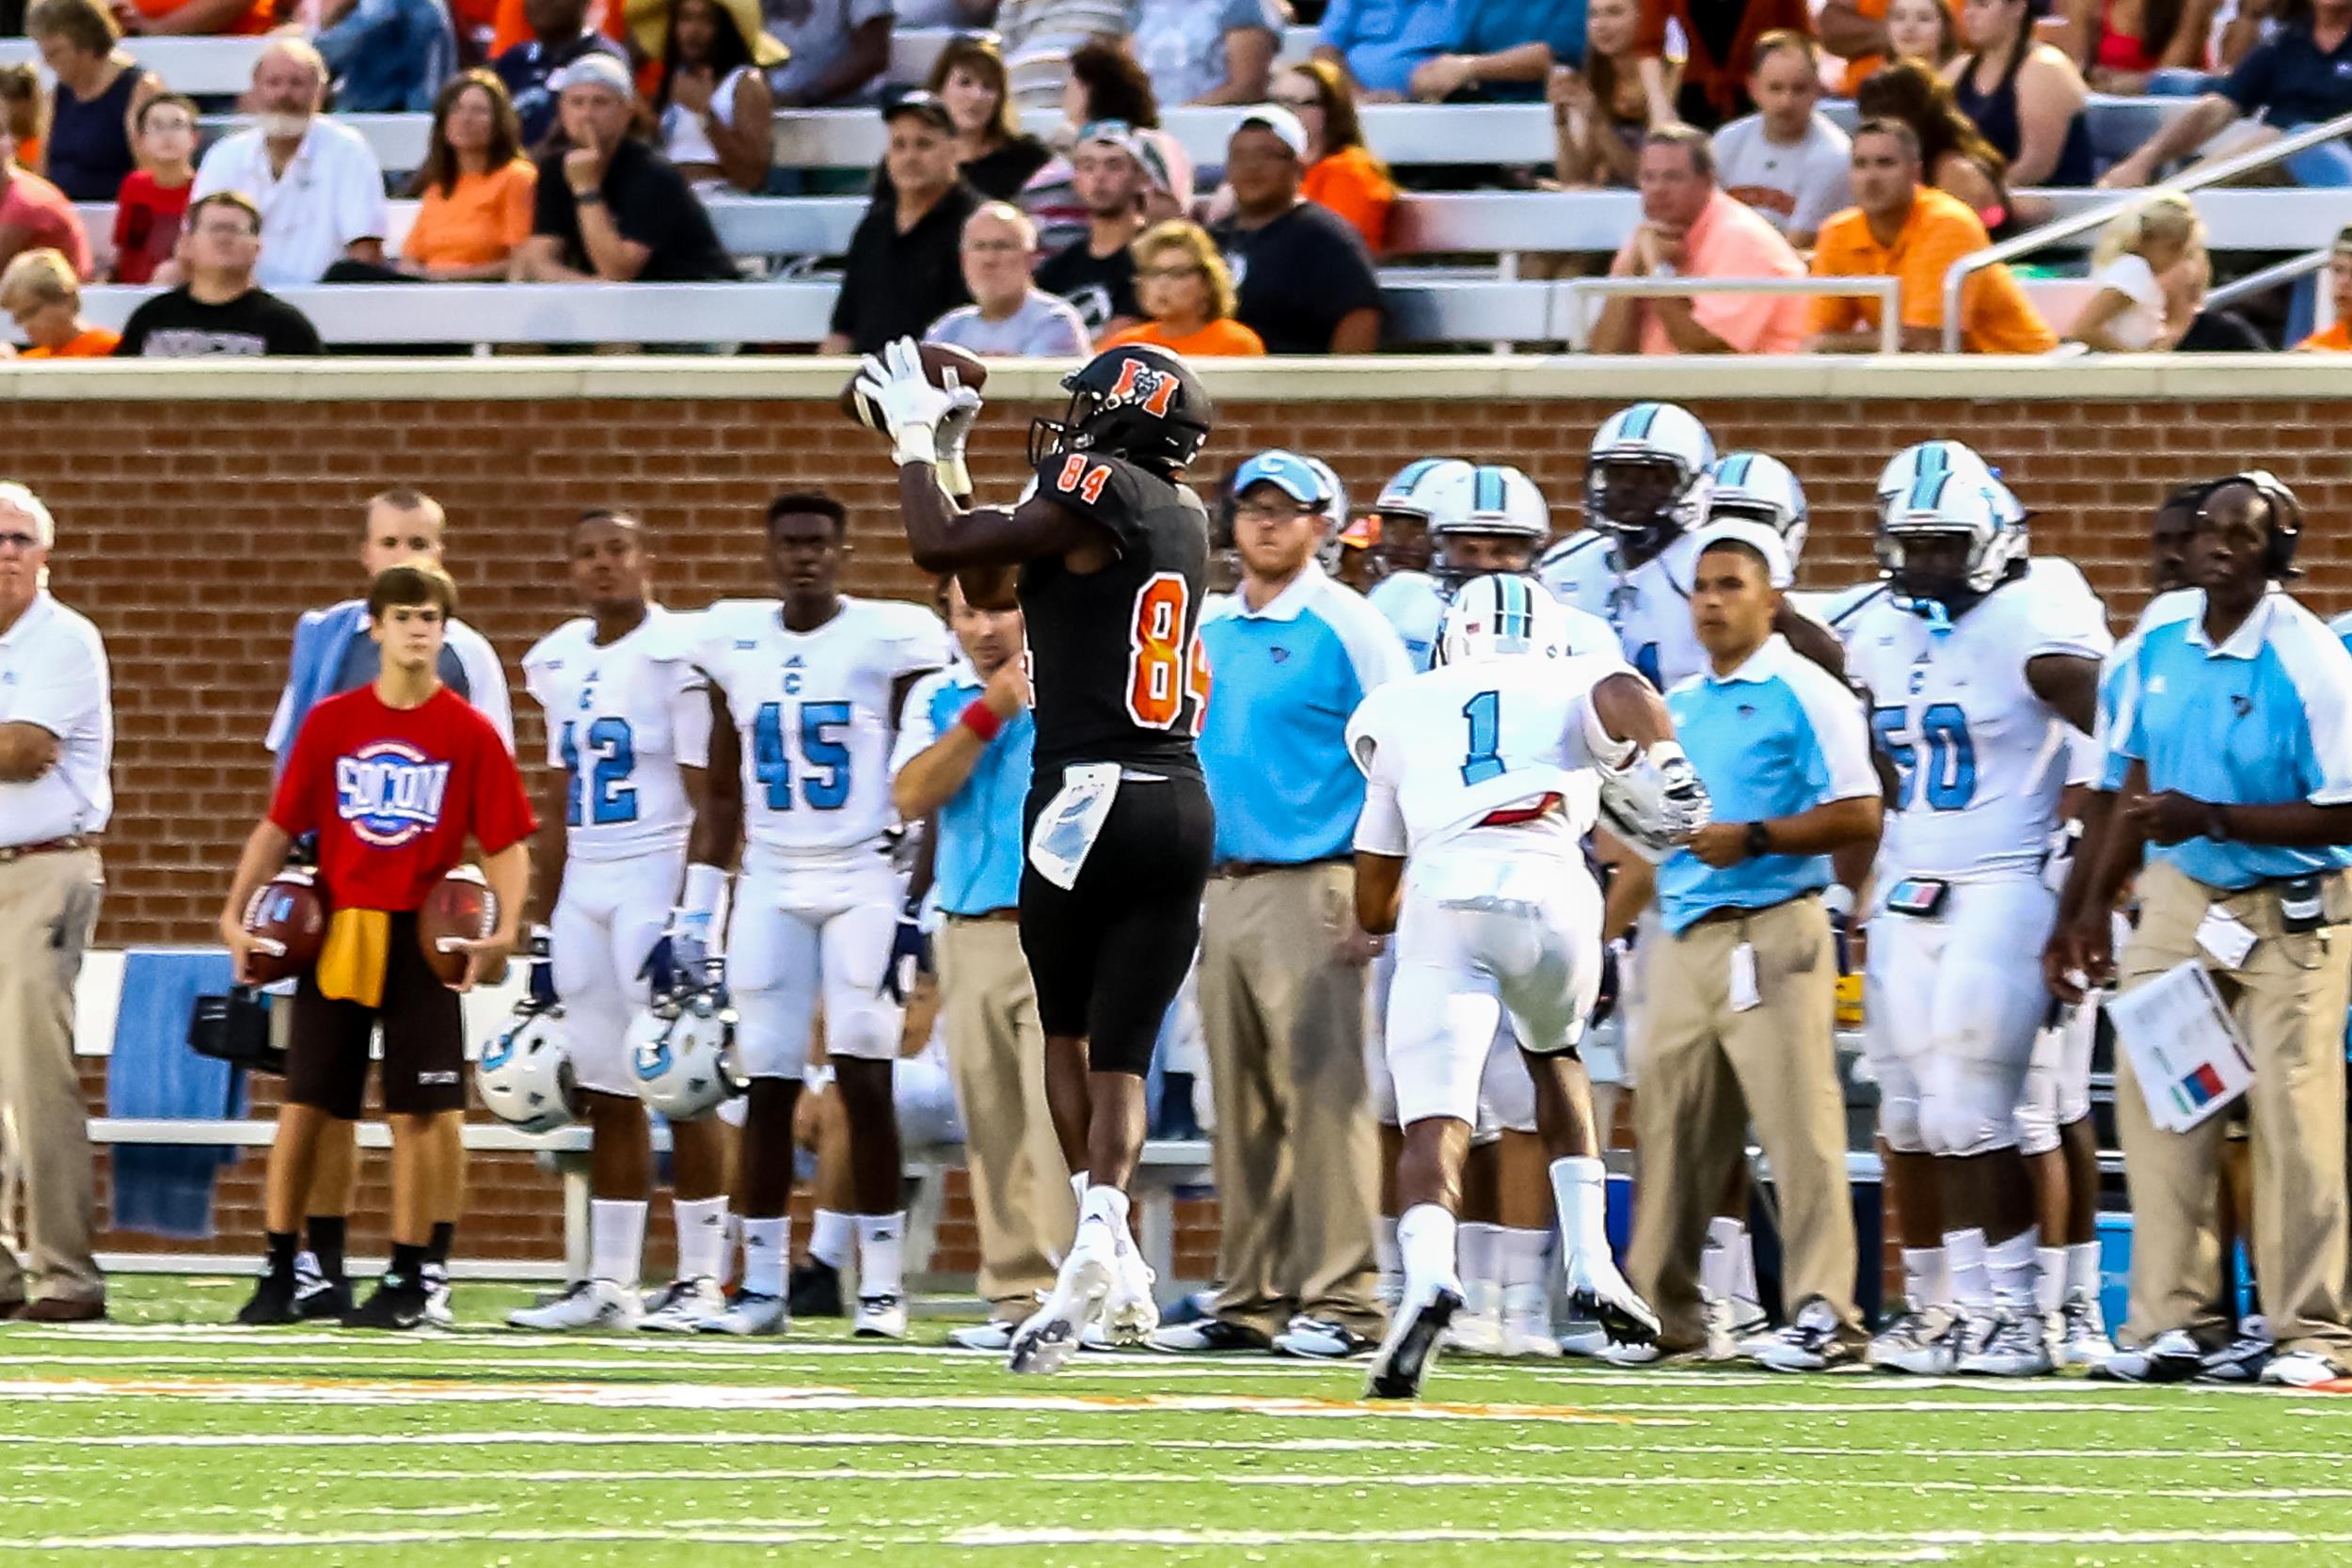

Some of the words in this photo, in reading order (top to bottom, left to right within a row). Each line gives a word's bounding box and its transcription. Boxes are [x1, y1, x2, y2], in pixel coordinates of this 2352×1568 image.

[1057, 452, 1113, 505] 84
[754, 700, 851, 810] 45
[1460, 689, 1506, 787] 1
[1871, 703, 1976, 811] 50
